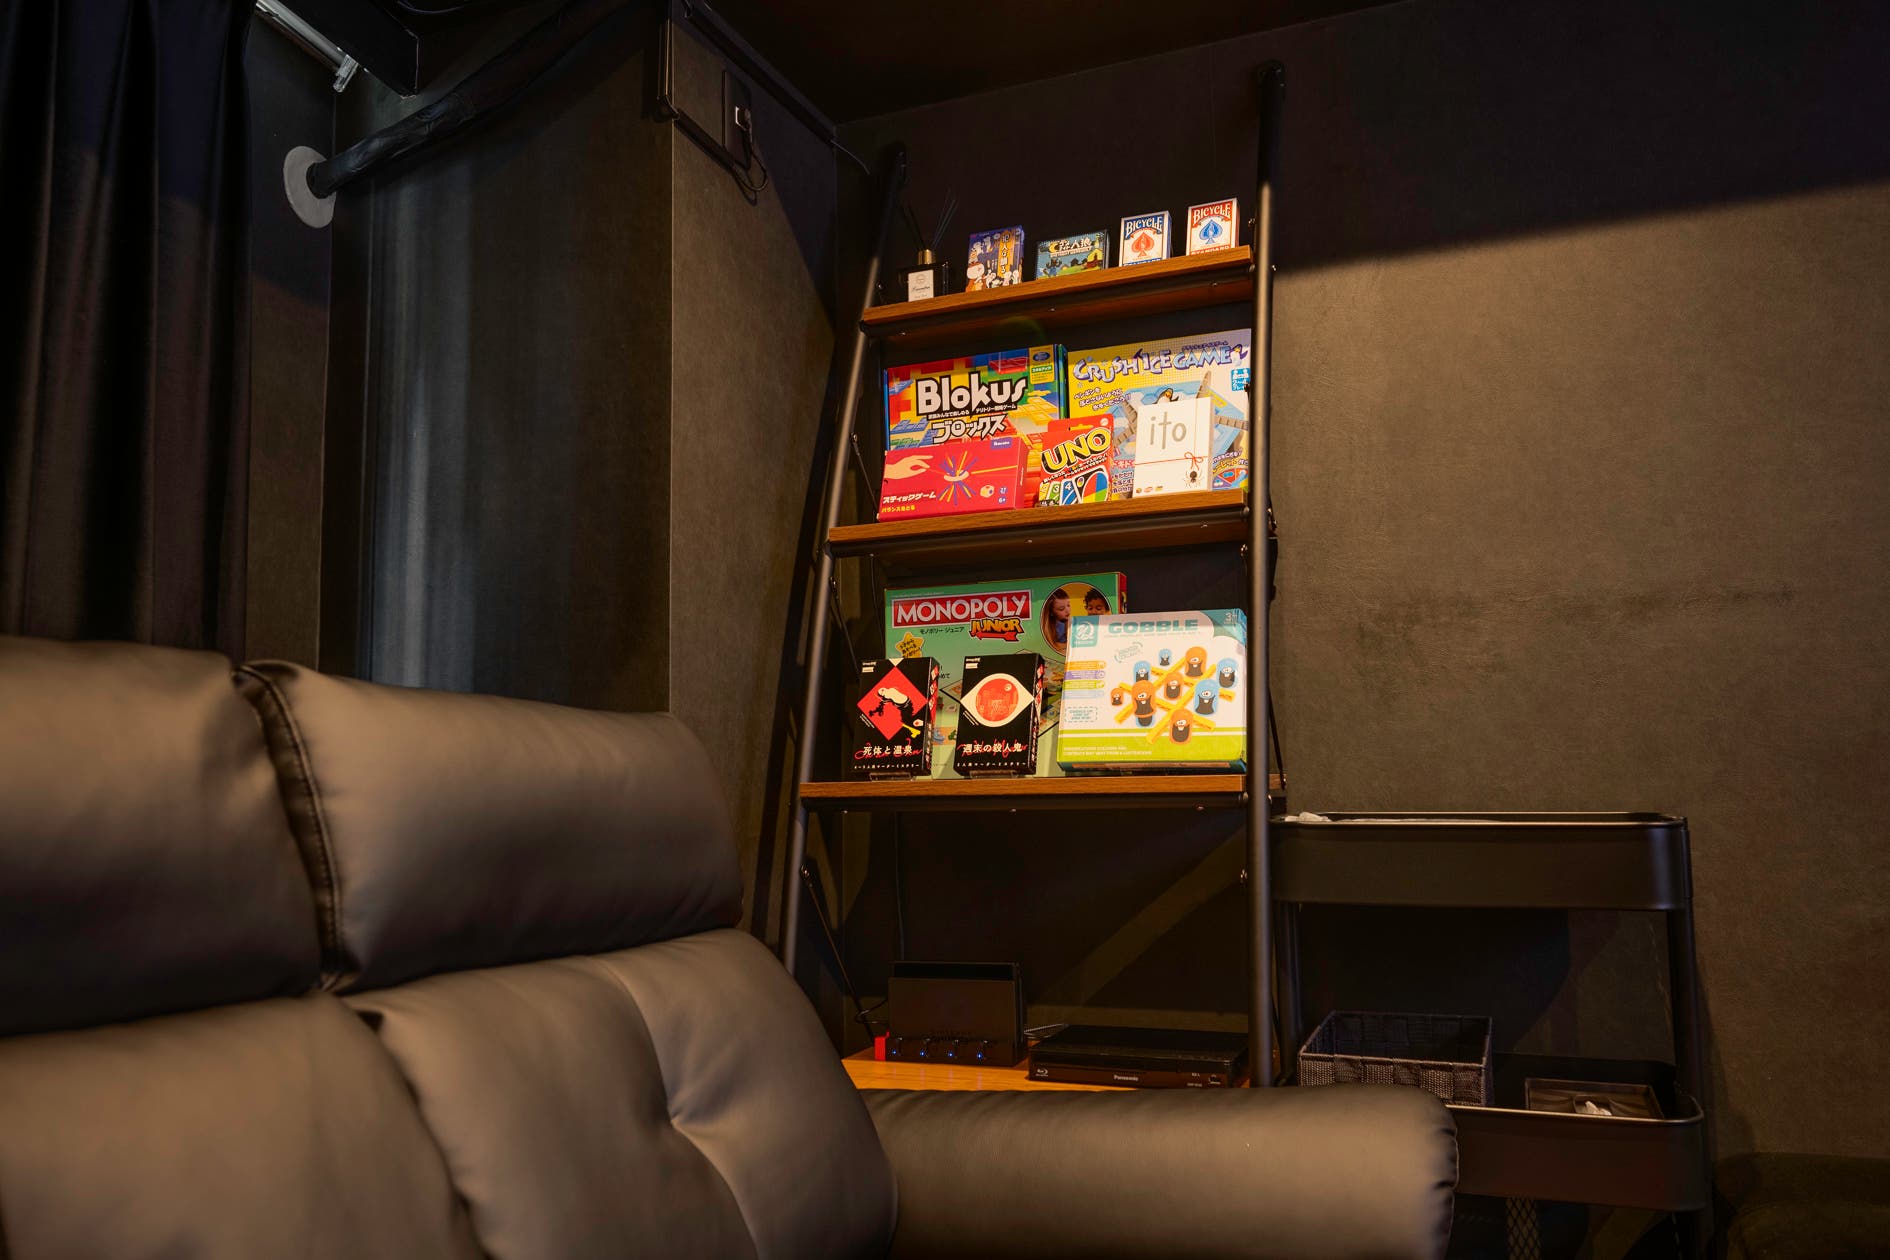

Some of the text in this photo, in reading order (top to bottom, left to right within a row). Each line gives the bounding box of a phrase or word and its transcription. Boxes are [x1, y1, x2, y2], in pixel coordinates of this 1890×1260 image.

[1193, 203, 1231, 226] BICYCLE
[1126, 216, 1163, 239] BICYCLE
[1073, 354, 1140, 383] CRUSH
[1142, 349, 1173, 375] ICE
[1173, 347, 1232, 370] GAME
[916, 371, 1028, 416] Blokus
[932, 413, 1008, 444] ブロックス
[1150, 411, 1187, 450] ito
[1042, 428, 1112, 473] UNO
[882, 491, 937, 504] スティックゲーム
[896, 596, 1027, 624] MONOPOLY
[970, 617, 1023, 634] JUNIOR
[1108, 618, 1199, 634] GOBBLE
[863, 745, 913, 757] 死体と温泉
[963, 742, 1023, 753] 週末の殺人鬼
